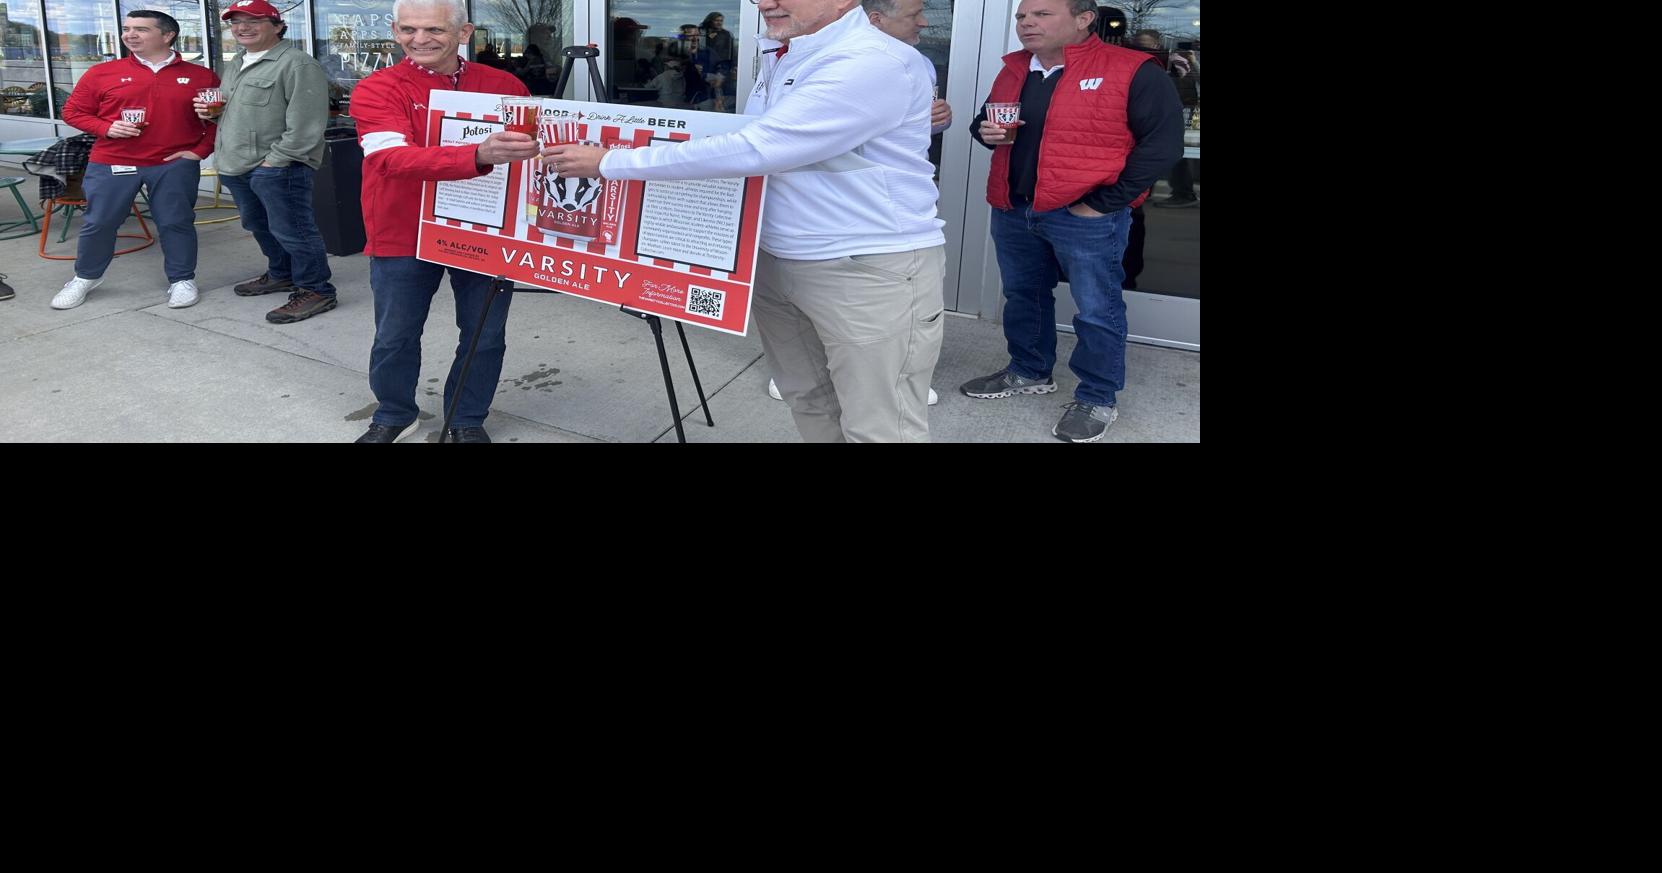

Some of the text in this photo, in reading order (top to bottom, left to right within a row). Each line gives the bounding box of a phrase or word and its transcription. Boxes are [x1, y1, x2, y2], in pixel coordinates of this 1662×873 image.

[339, 13, 394, 27] TAPS
[340, 30, 377, 40] APPS
[338, 52, 394, 71] PIZZA
[1079, 77, 1104, 91] W
[543, 108, 569, 117] OOD
[647, 117, 687, 129] BEER
[608, 179, 619, 221] ARSITY
[538, 208, 598, 226] VARSITY
[436, 239, 448, 247] 4%
[450, 241, 489, 256] ALC/VOL
[501, 247, 632, 288] VARSITY
[534, 272, 590, 291] GOLDEN ALE
